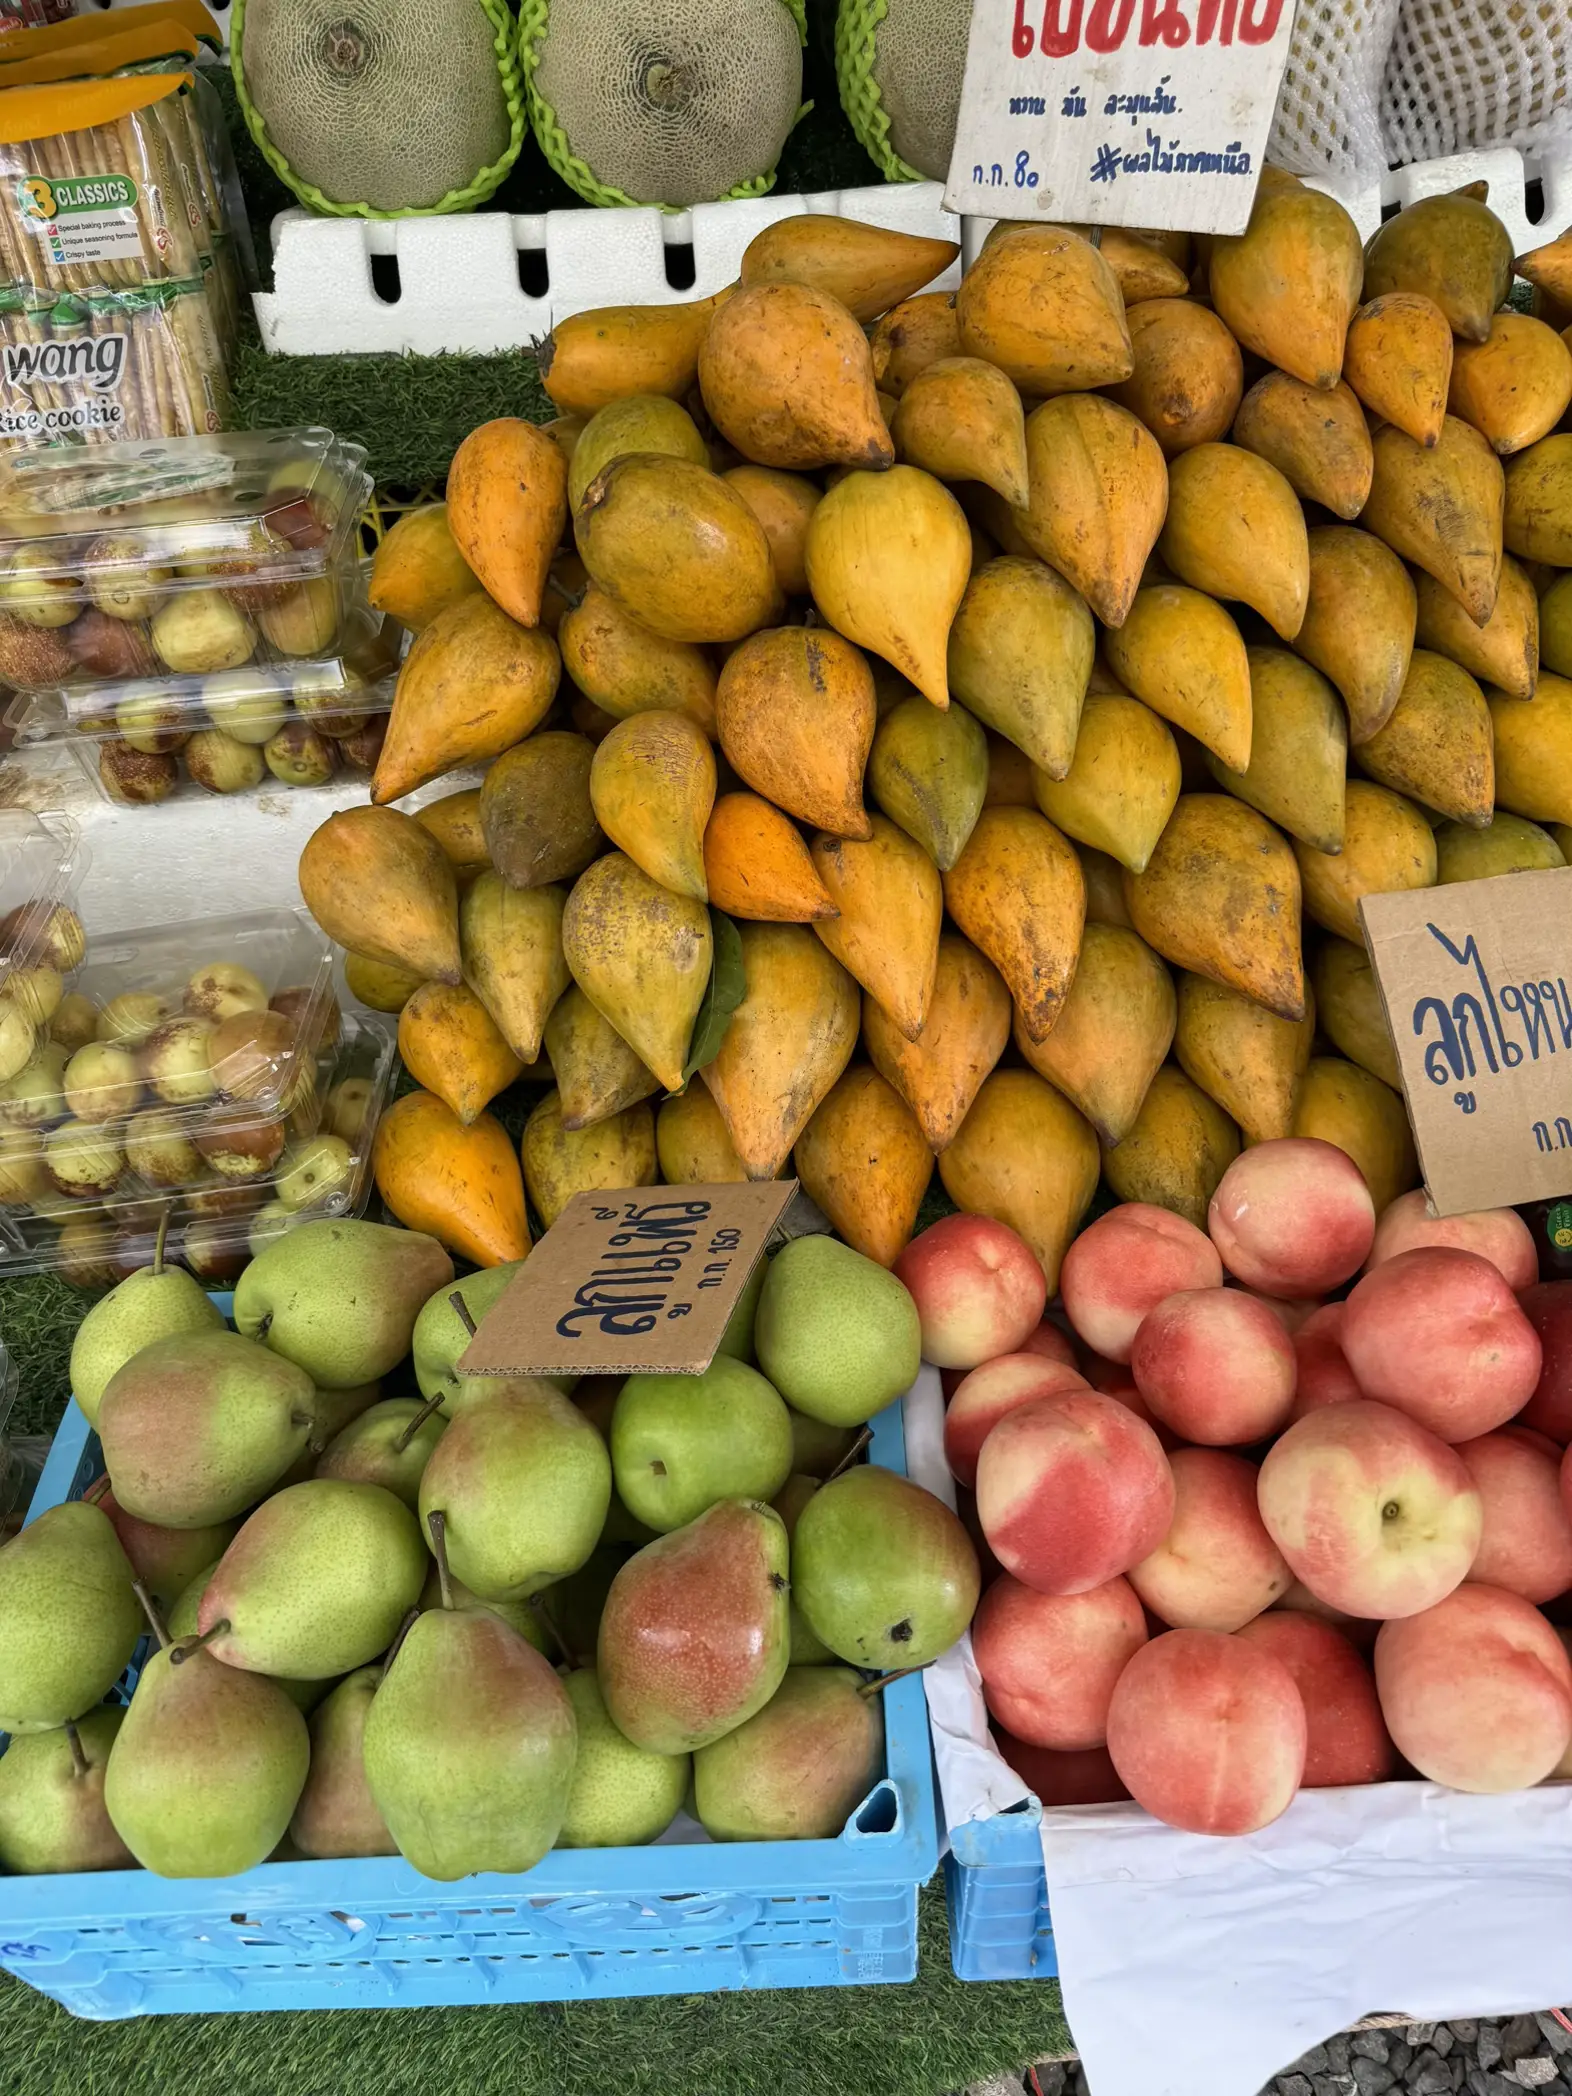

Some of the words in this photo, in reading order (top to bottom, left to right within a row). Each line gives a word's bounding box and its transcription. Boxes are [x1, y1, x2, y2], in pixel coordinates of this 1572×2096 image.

[24, 179, 57, 218] 3
[56, 181, 129, 206] CLASSICS
[58, 223, 80, 233] Special
[81, 221, 102, 230] baking
[103, 219, 126, 228] process
[61, 238, 84, 246] Unique
[84, 234, 115, 243] seasoning
[115, 232, 138, 240] formula
[65, 251, 85, 259] Crispy
[85, 249, 101, 257] taste
[7, 337, 123, 389] wang
[45, 399, 121, 428] cookie
[707, 1228, 742, 1254] 150
